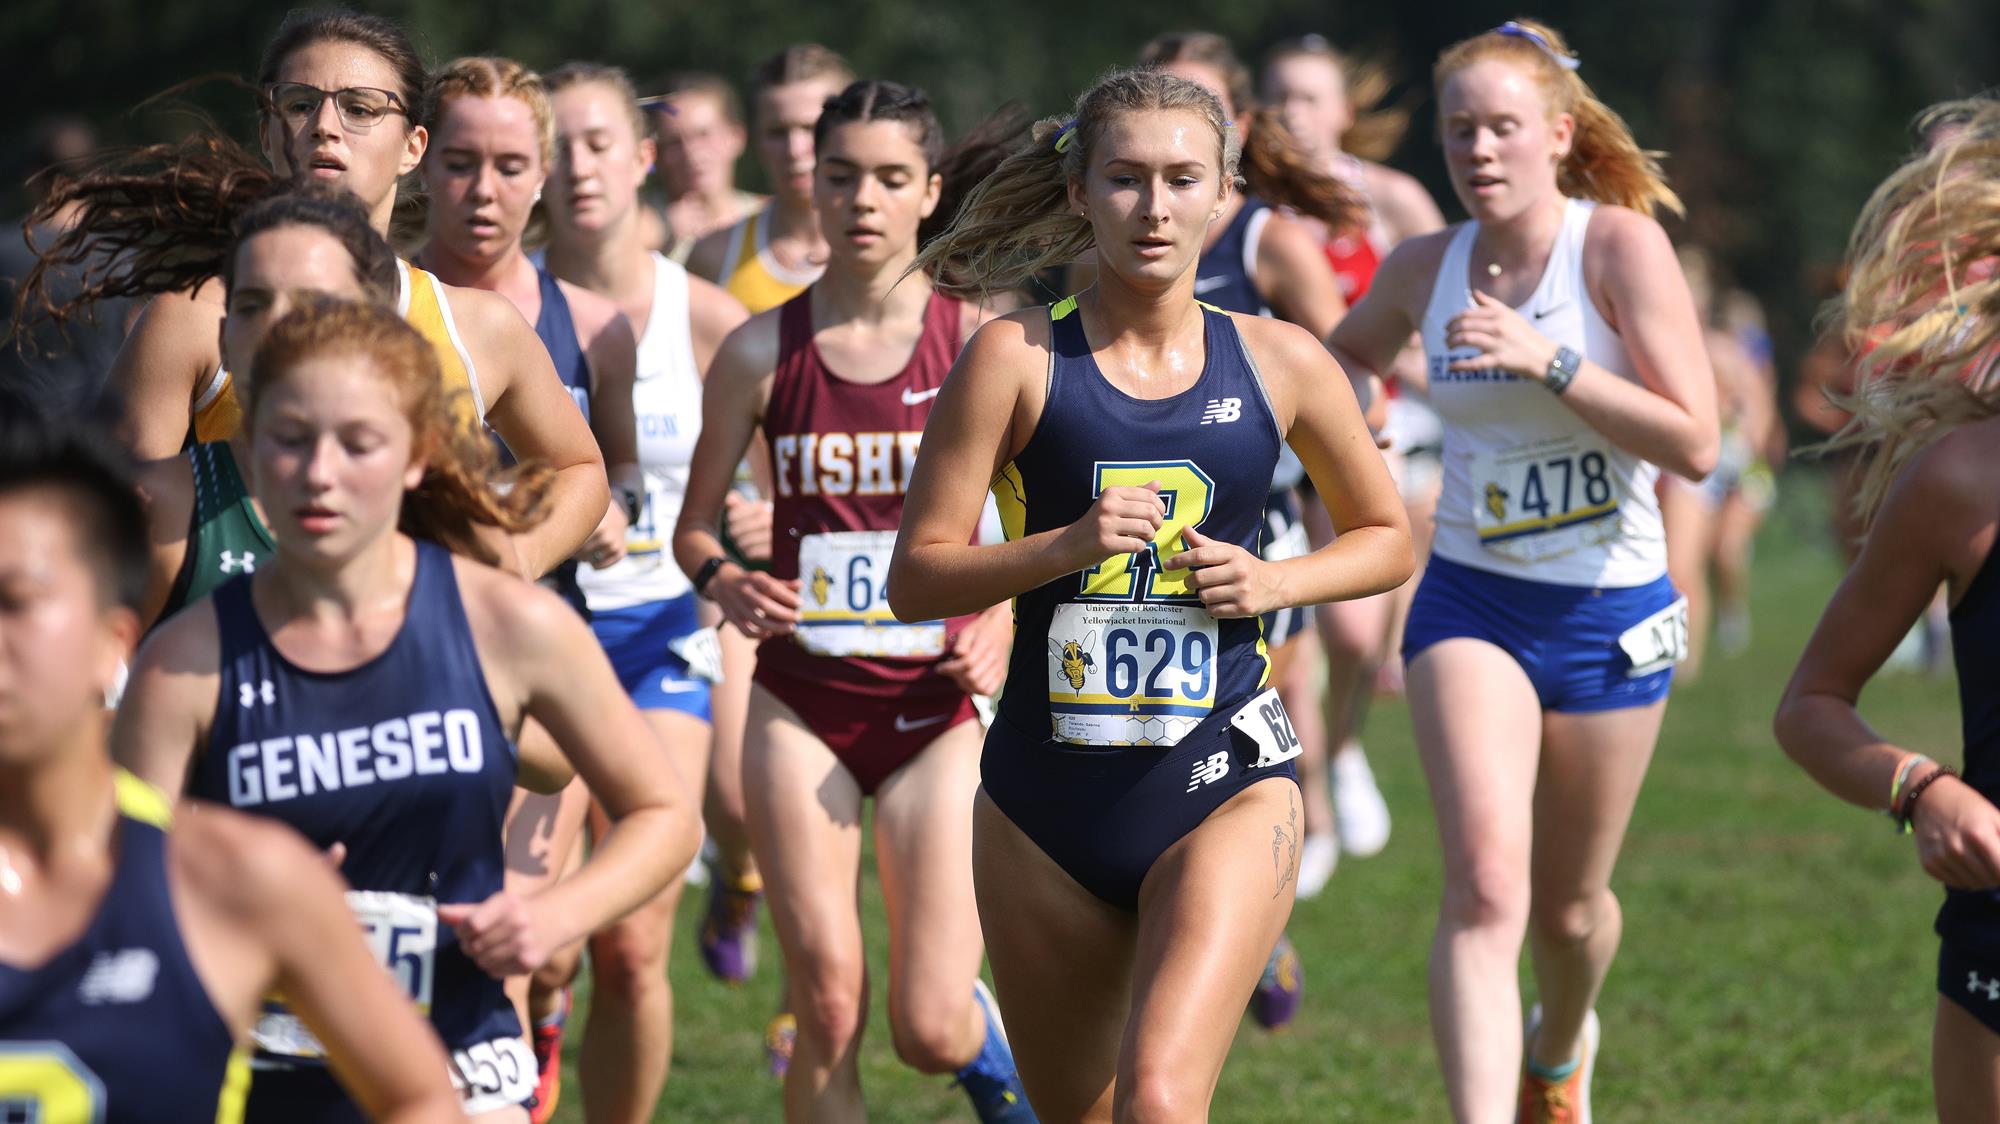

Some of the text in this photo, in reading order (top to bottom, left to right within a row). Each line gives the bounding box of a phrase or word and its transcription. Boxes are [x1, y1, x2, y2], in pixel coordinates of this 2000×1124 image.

[1521, 450, 1611, 518] 478
[1073, 458, 1216, 602] R
[847, 555, 889, 612] 6
[1085, 603, 1183, 614] University of Rochester
[1082, 616, 1186, 627] Yellowjacket Invitational
[1105, 628, 1212, 701] 629
[227, 708, 485, 807] GENESEO
[1258, 697, 1299, 753] 62
[358, 923, 422, 1002] 5
